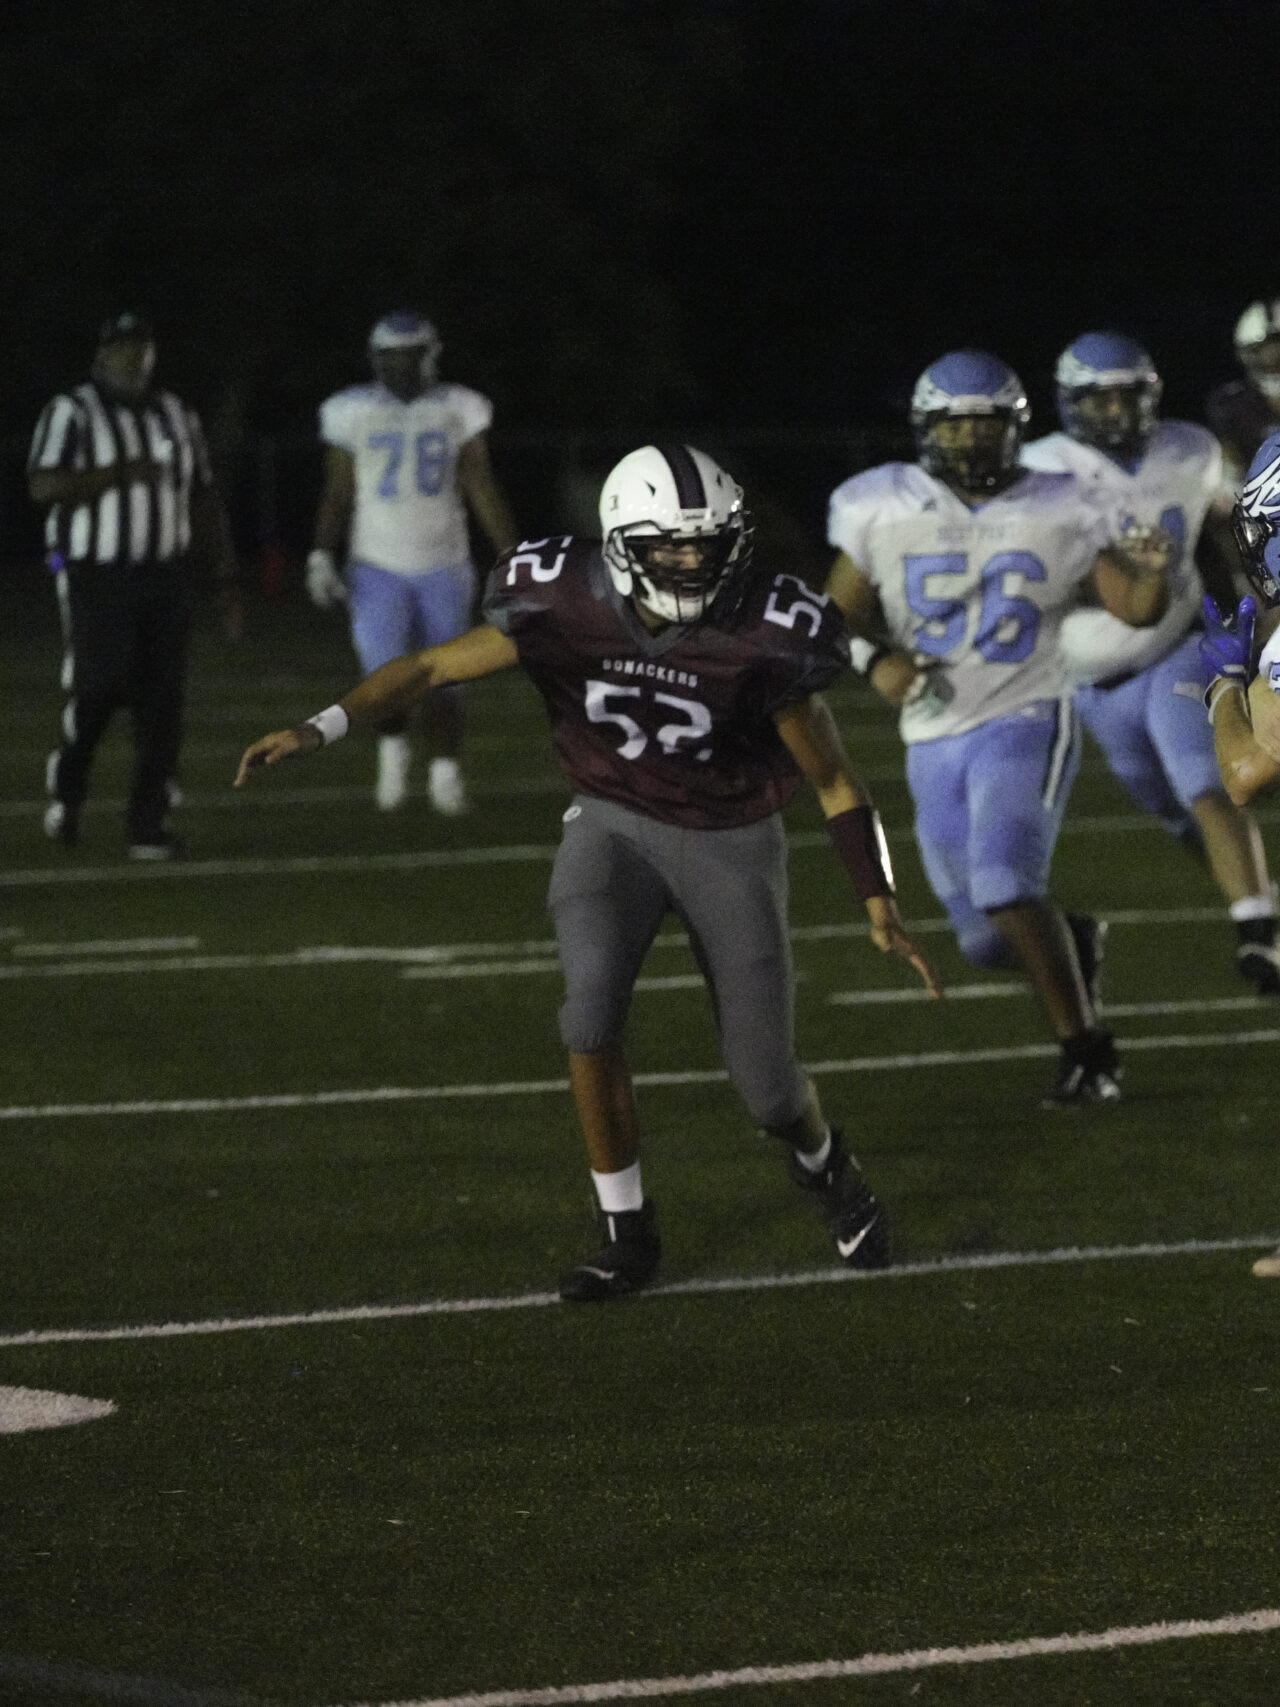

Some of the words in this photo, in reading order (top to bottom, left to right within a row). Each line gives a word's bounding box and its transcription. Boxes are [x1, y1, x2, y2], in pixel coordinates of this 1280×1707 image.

[762, 573, 830, 639] 52
[904, 550, 1048, 663] 56
[585, 679, 712, 761] 52
